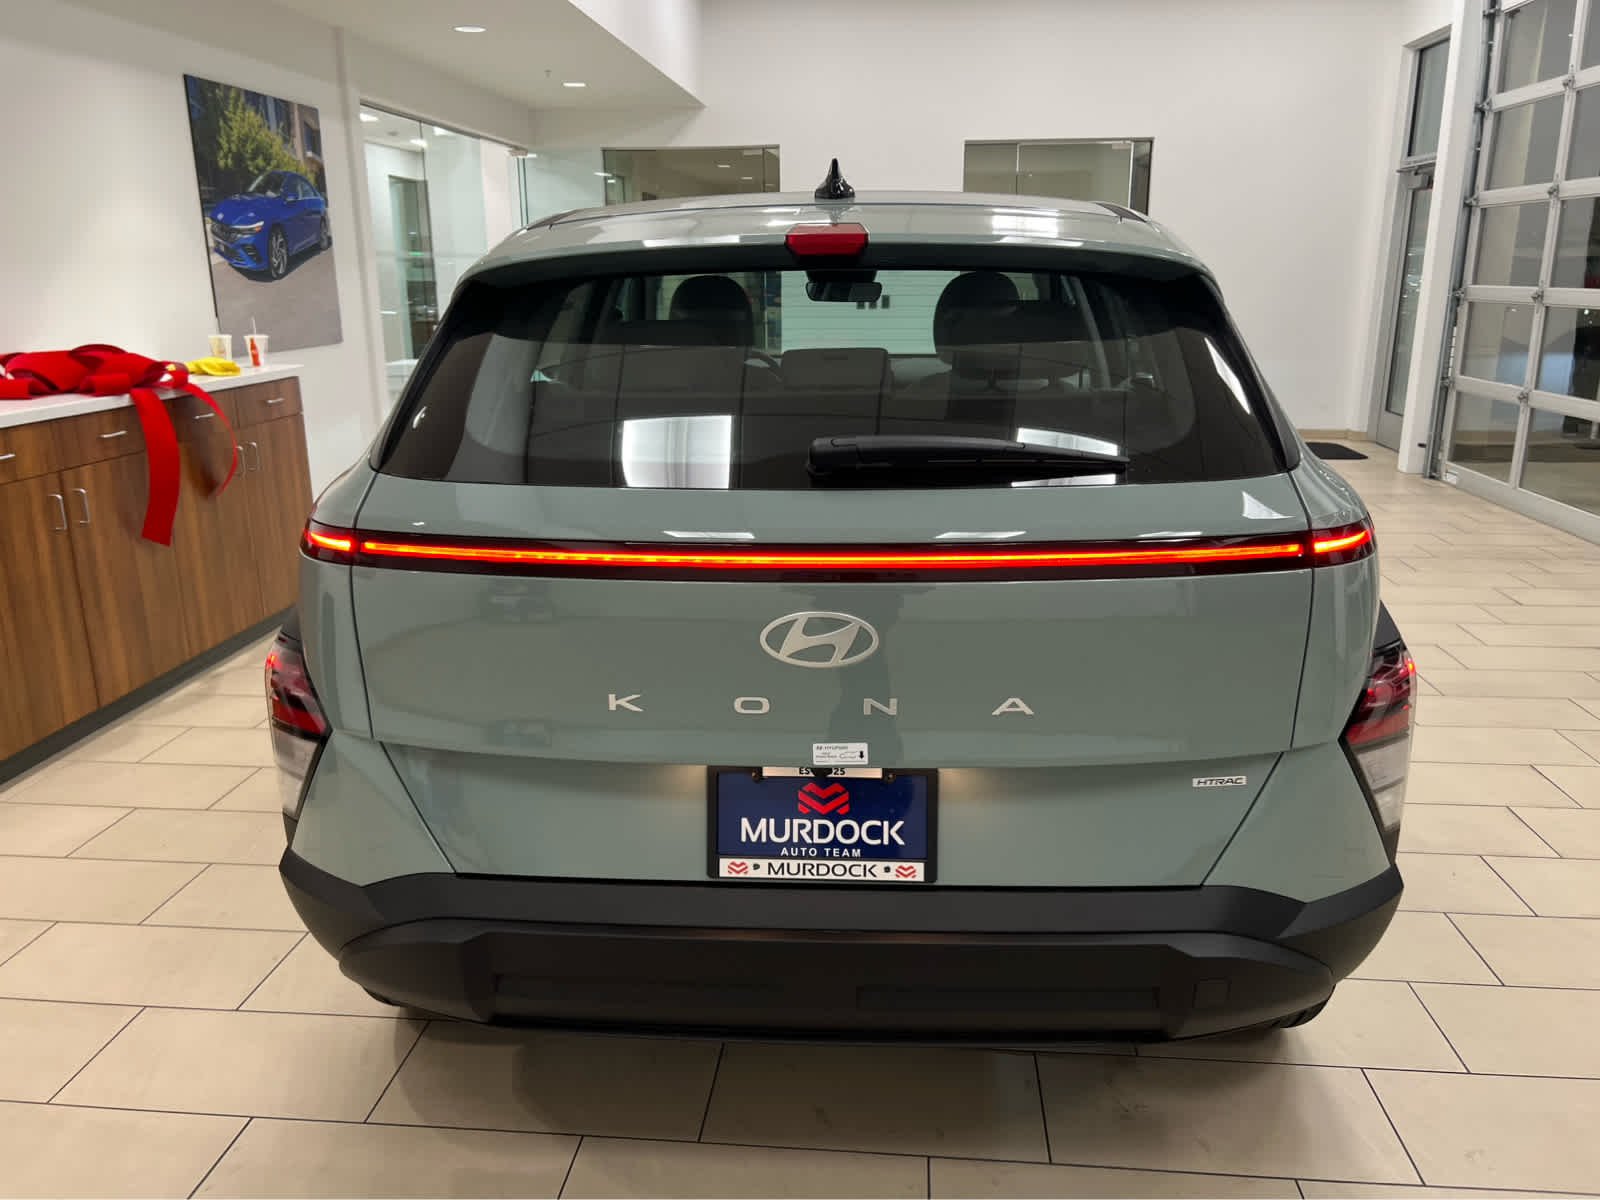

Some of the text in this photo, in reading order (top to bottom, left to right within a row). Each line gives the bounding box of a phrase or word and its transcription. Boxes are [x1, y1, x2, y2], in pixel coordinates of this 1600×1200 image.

[1197, 777, 1244, 785] HTRAC
[741, 818, 905, 846] MURDOCK
[781, 848, 861, 858] AUTO TEAM
[767, 862, 878, 878] MURDOCK
